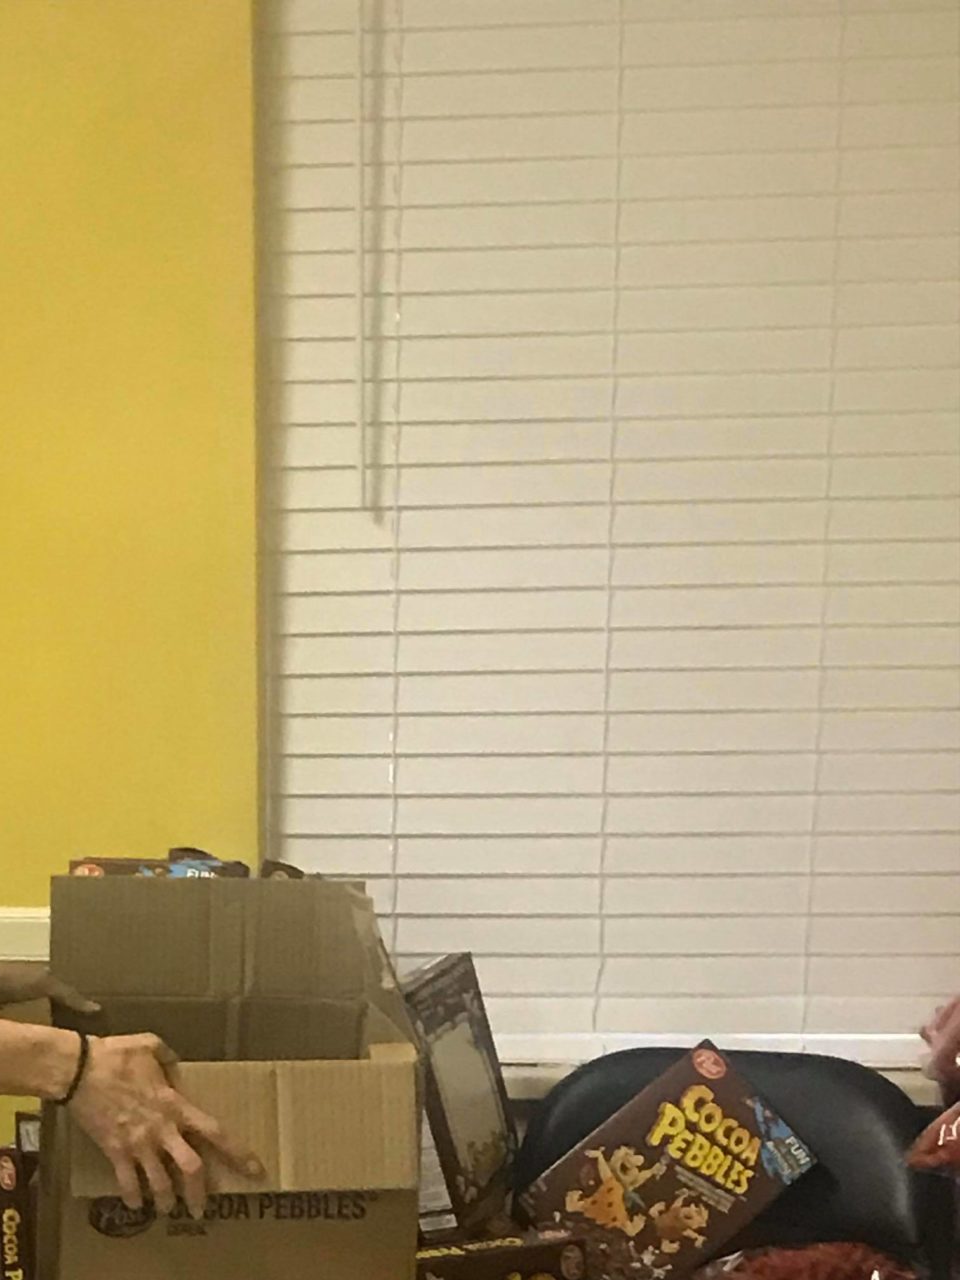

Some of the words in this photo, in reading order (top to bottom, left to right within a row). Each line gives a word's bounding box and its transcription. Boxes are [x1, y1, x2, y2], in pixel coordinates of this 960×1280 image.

[646, 1102, 755, 1194] PEBBLES
[681, 1085, 762, 1166] COCOA
[785, 1136, 811, 1165] FUN
[3, 1208, 20, 1265] COCOA
